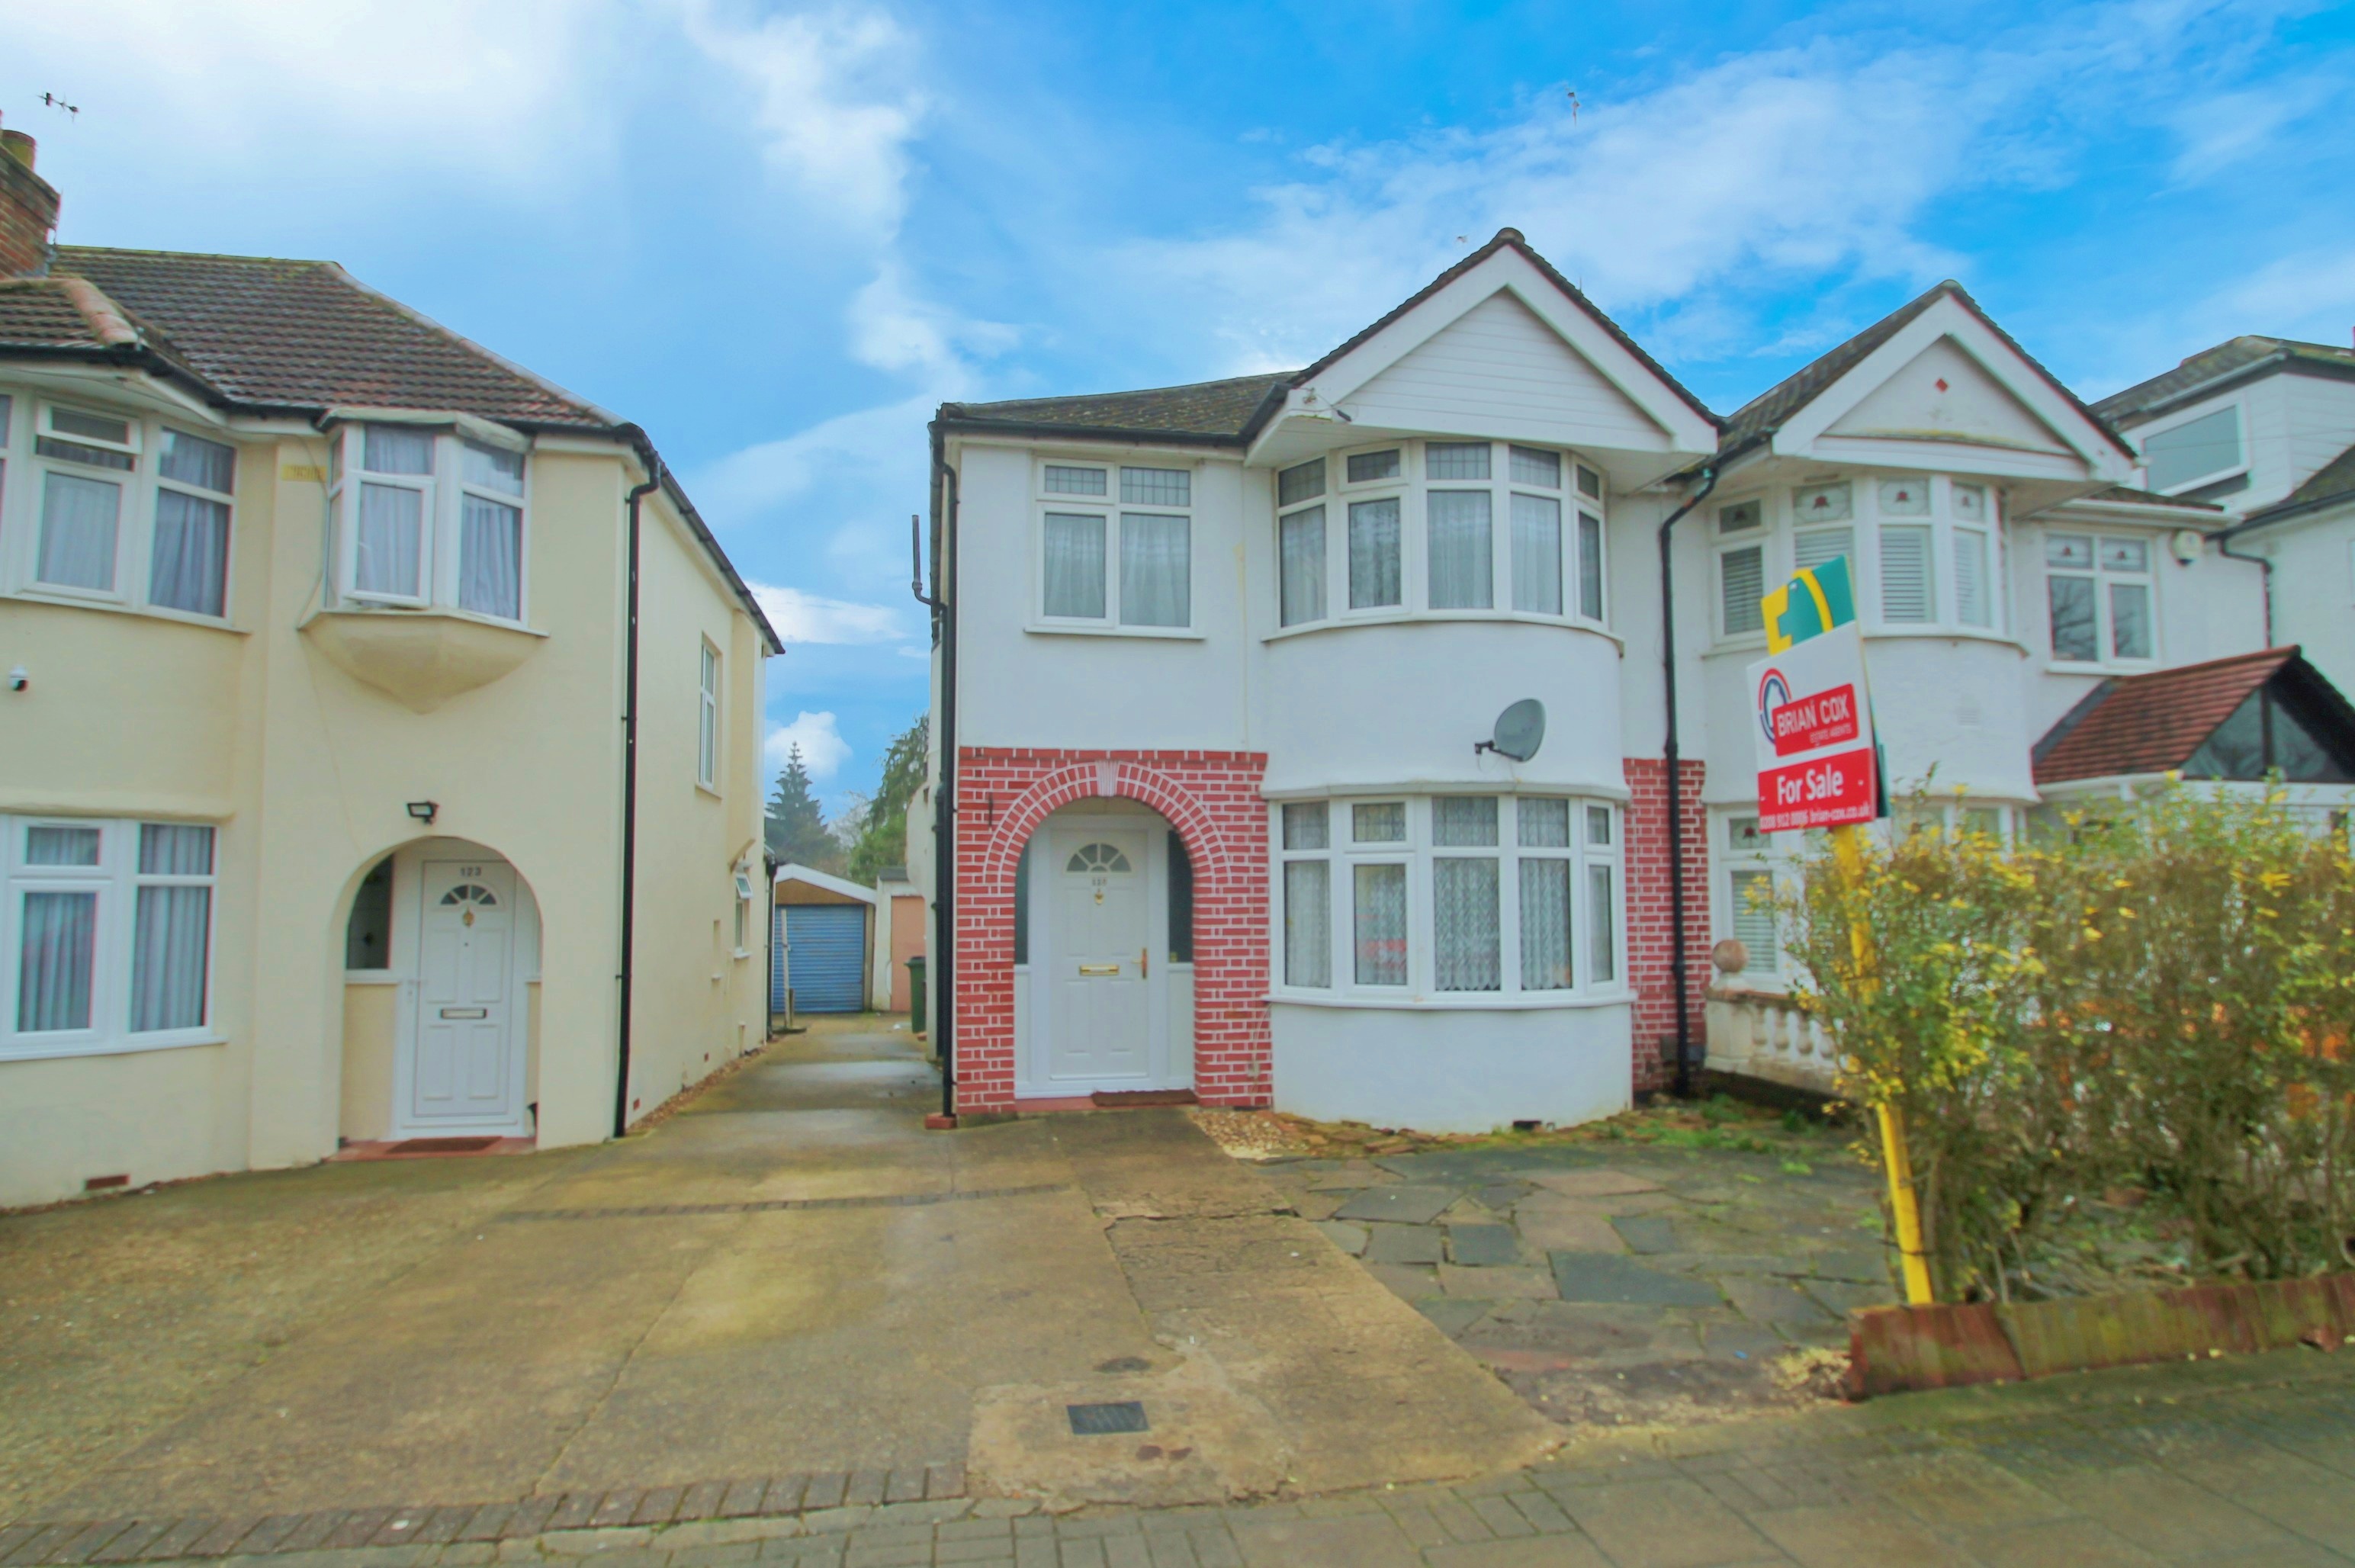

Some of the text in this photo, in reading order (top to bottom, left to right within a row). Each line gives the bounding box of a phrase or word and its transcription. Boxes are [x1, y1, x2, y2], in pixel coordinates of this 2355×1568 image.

[1777, 694, 1849, 737] BRIAN COX
[1777, 763, 1843, 805] For Sale
[460, 866, 482, 877] 123
